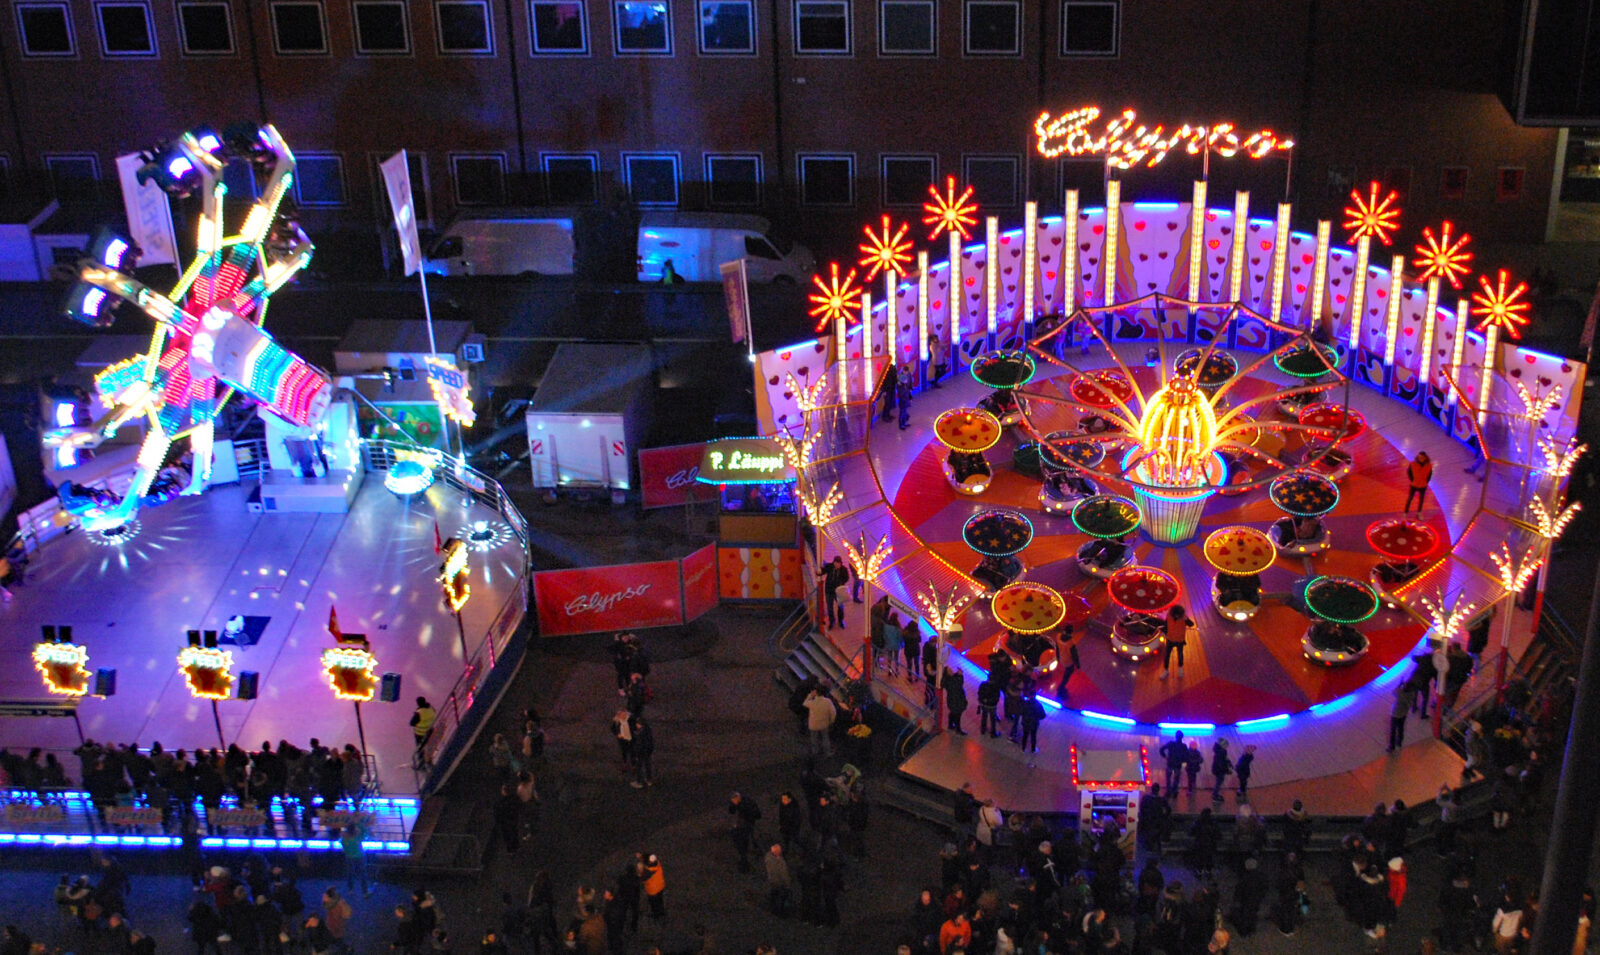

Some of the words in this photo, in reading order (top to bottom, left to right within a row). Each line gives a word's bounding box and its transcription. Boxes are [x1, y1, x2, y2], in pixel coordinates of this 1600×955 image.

[1034, 106, 1294, 169] Calypso
[709, 451, 724, 470] P.
[564, 583, 653, 616] Calypso
